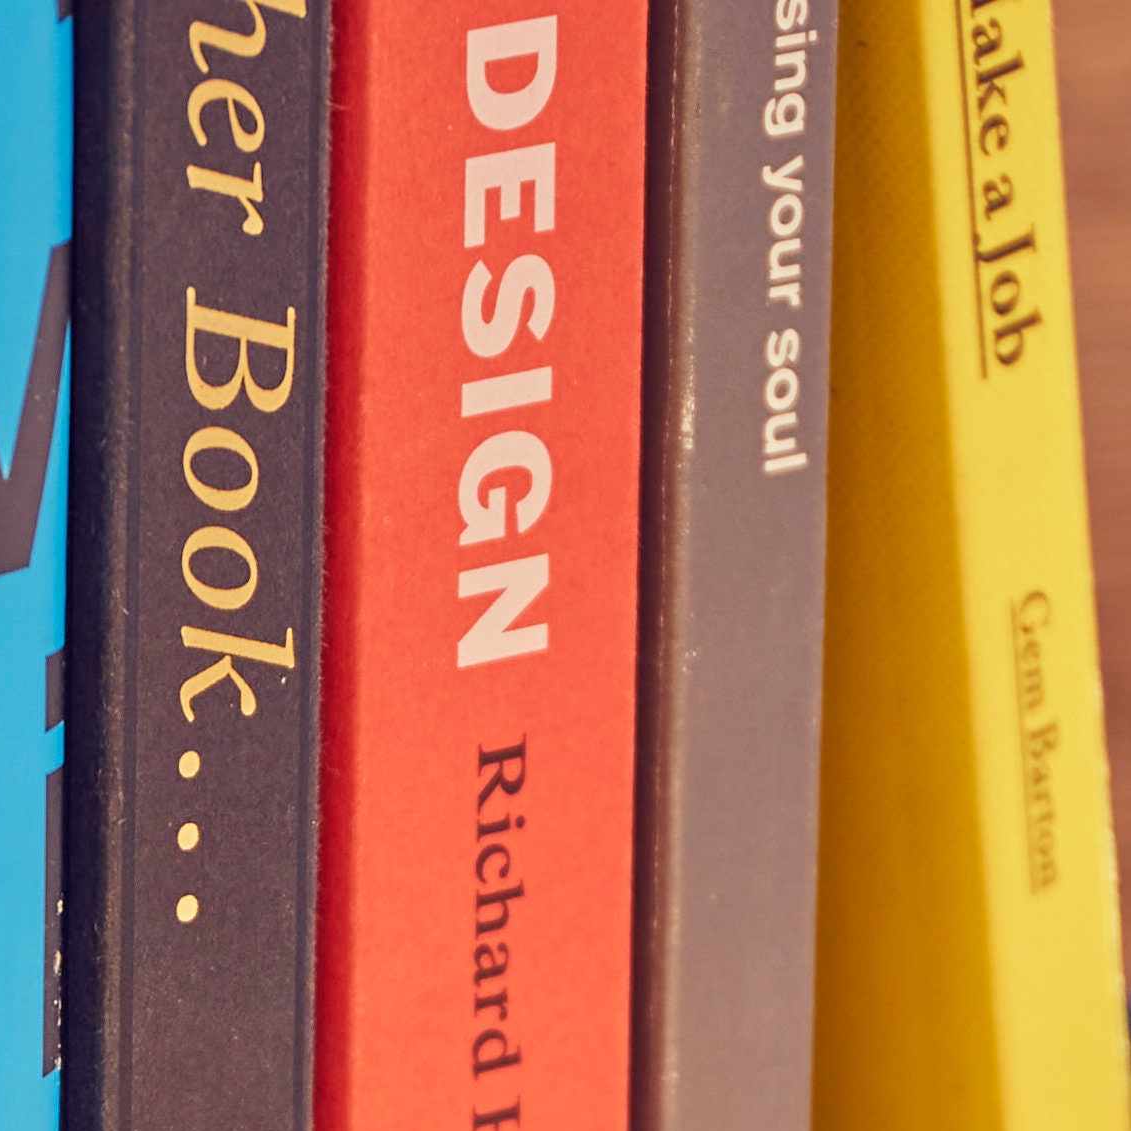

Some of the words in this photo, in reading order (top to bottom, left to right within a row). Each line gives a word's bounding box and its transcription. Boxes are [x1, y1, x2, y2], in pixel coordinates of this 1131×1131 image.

[763, 0, 817, 138] sing
[970, 0, 1024, 156] ake
[761, 155, 804, 308] your
[983, 173, 1014, 221] a
[455, 14, 557, 668] DESIGN
[975, 223, 1042, 366] Job
[763, 327, 809, 474] soul
[470, 732, 528, 1080] Richard
